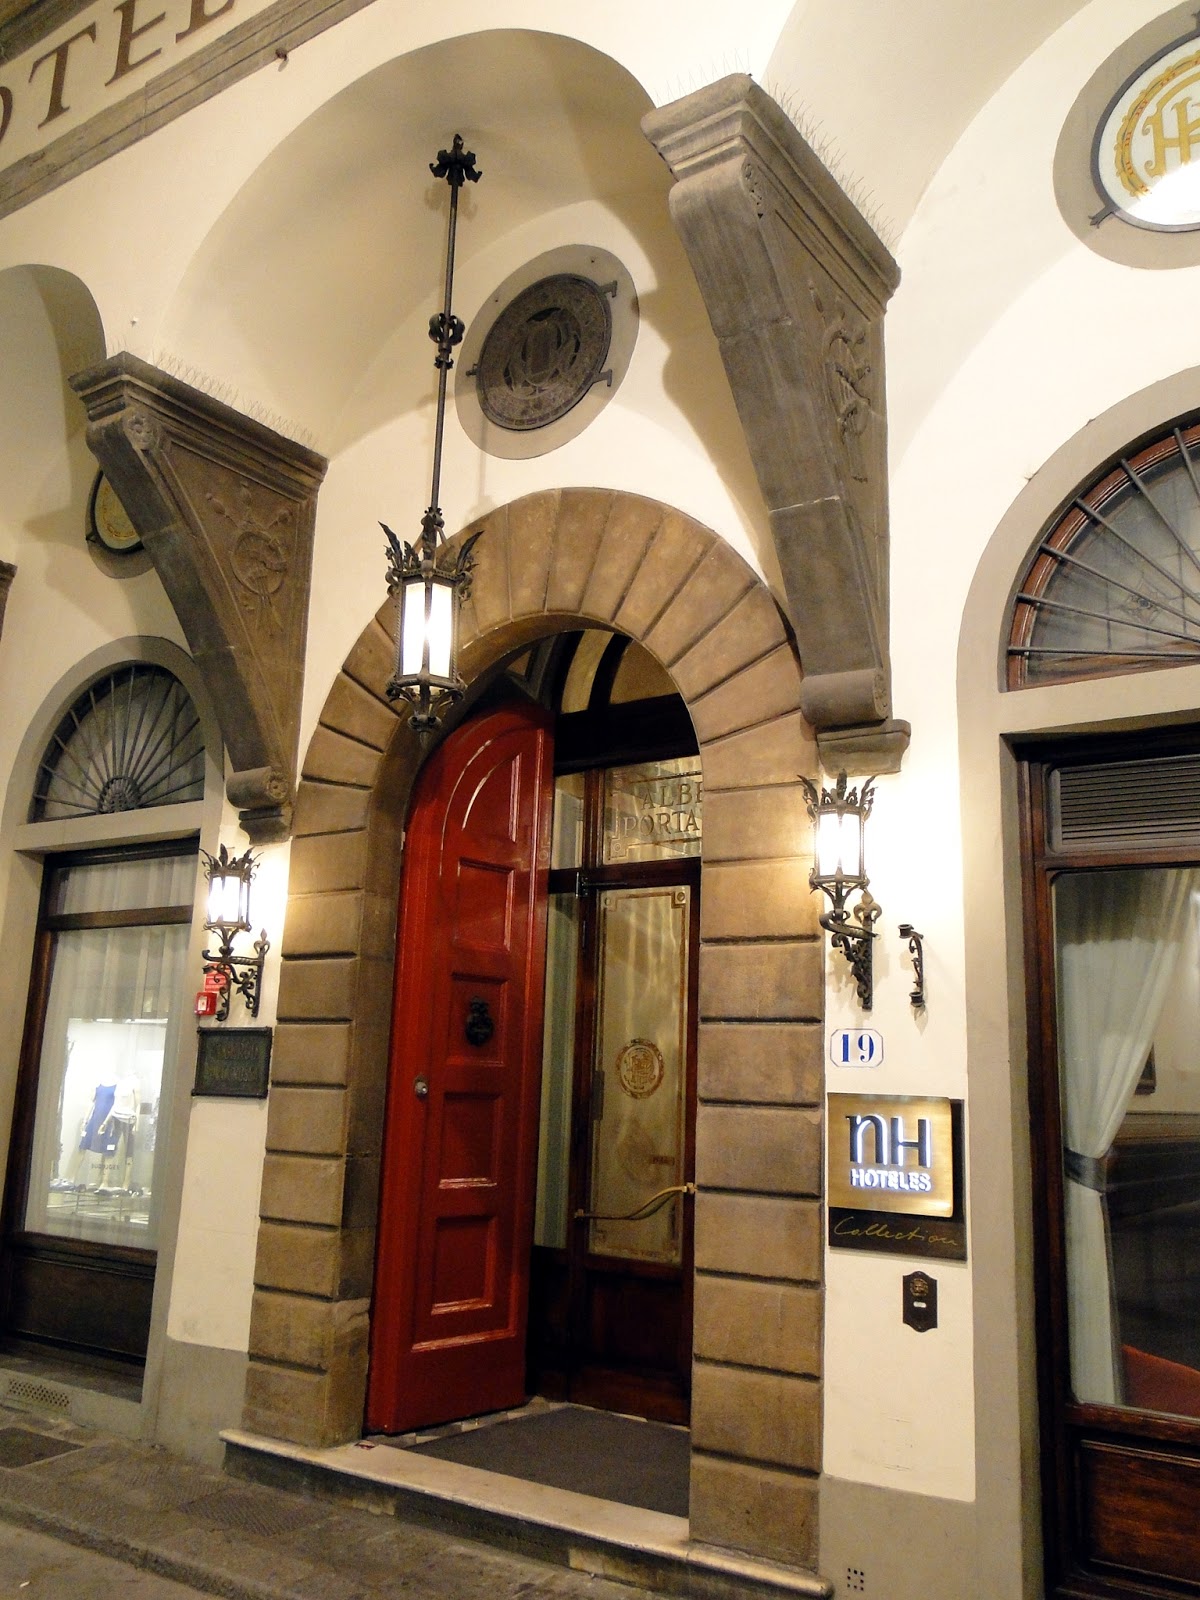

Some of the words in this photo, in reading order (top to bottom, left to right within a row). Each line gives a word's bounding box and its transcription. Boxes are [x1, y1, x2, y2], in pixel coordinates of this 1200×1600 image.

[623, 809, 700, 838] PORTA
[841, 1033, 875, 1063] 19
[850, 1168, 932, 1192] HOTELES
[833, 1216, 957, 1246] Collection
